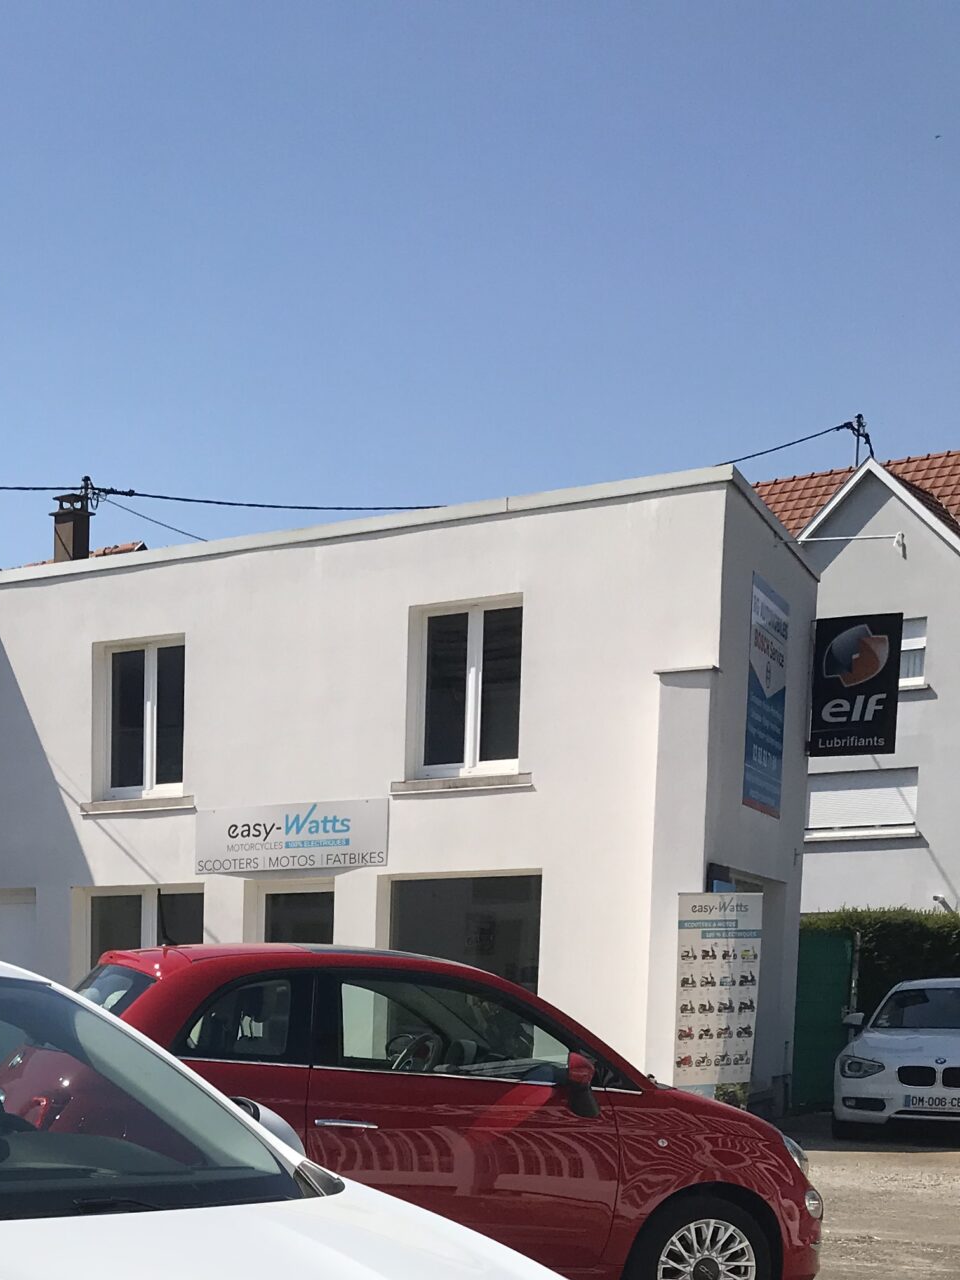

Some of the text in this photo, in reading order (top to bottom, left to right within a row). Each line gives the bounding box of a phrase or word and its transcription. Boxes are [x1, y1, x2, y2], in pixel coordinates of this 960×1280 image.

[821, 693, 887, 723] elf
[818, 735, 885, 748] Lubrifiants
[227, 803, 351, 842] easy-Watts
[226, 842, 283, 852] MOTORCYCLES
[198, 851, 385, 872] SCOOTERS MOTOS FATBIKES
[691, 897, 749, 915] easy-Watts
